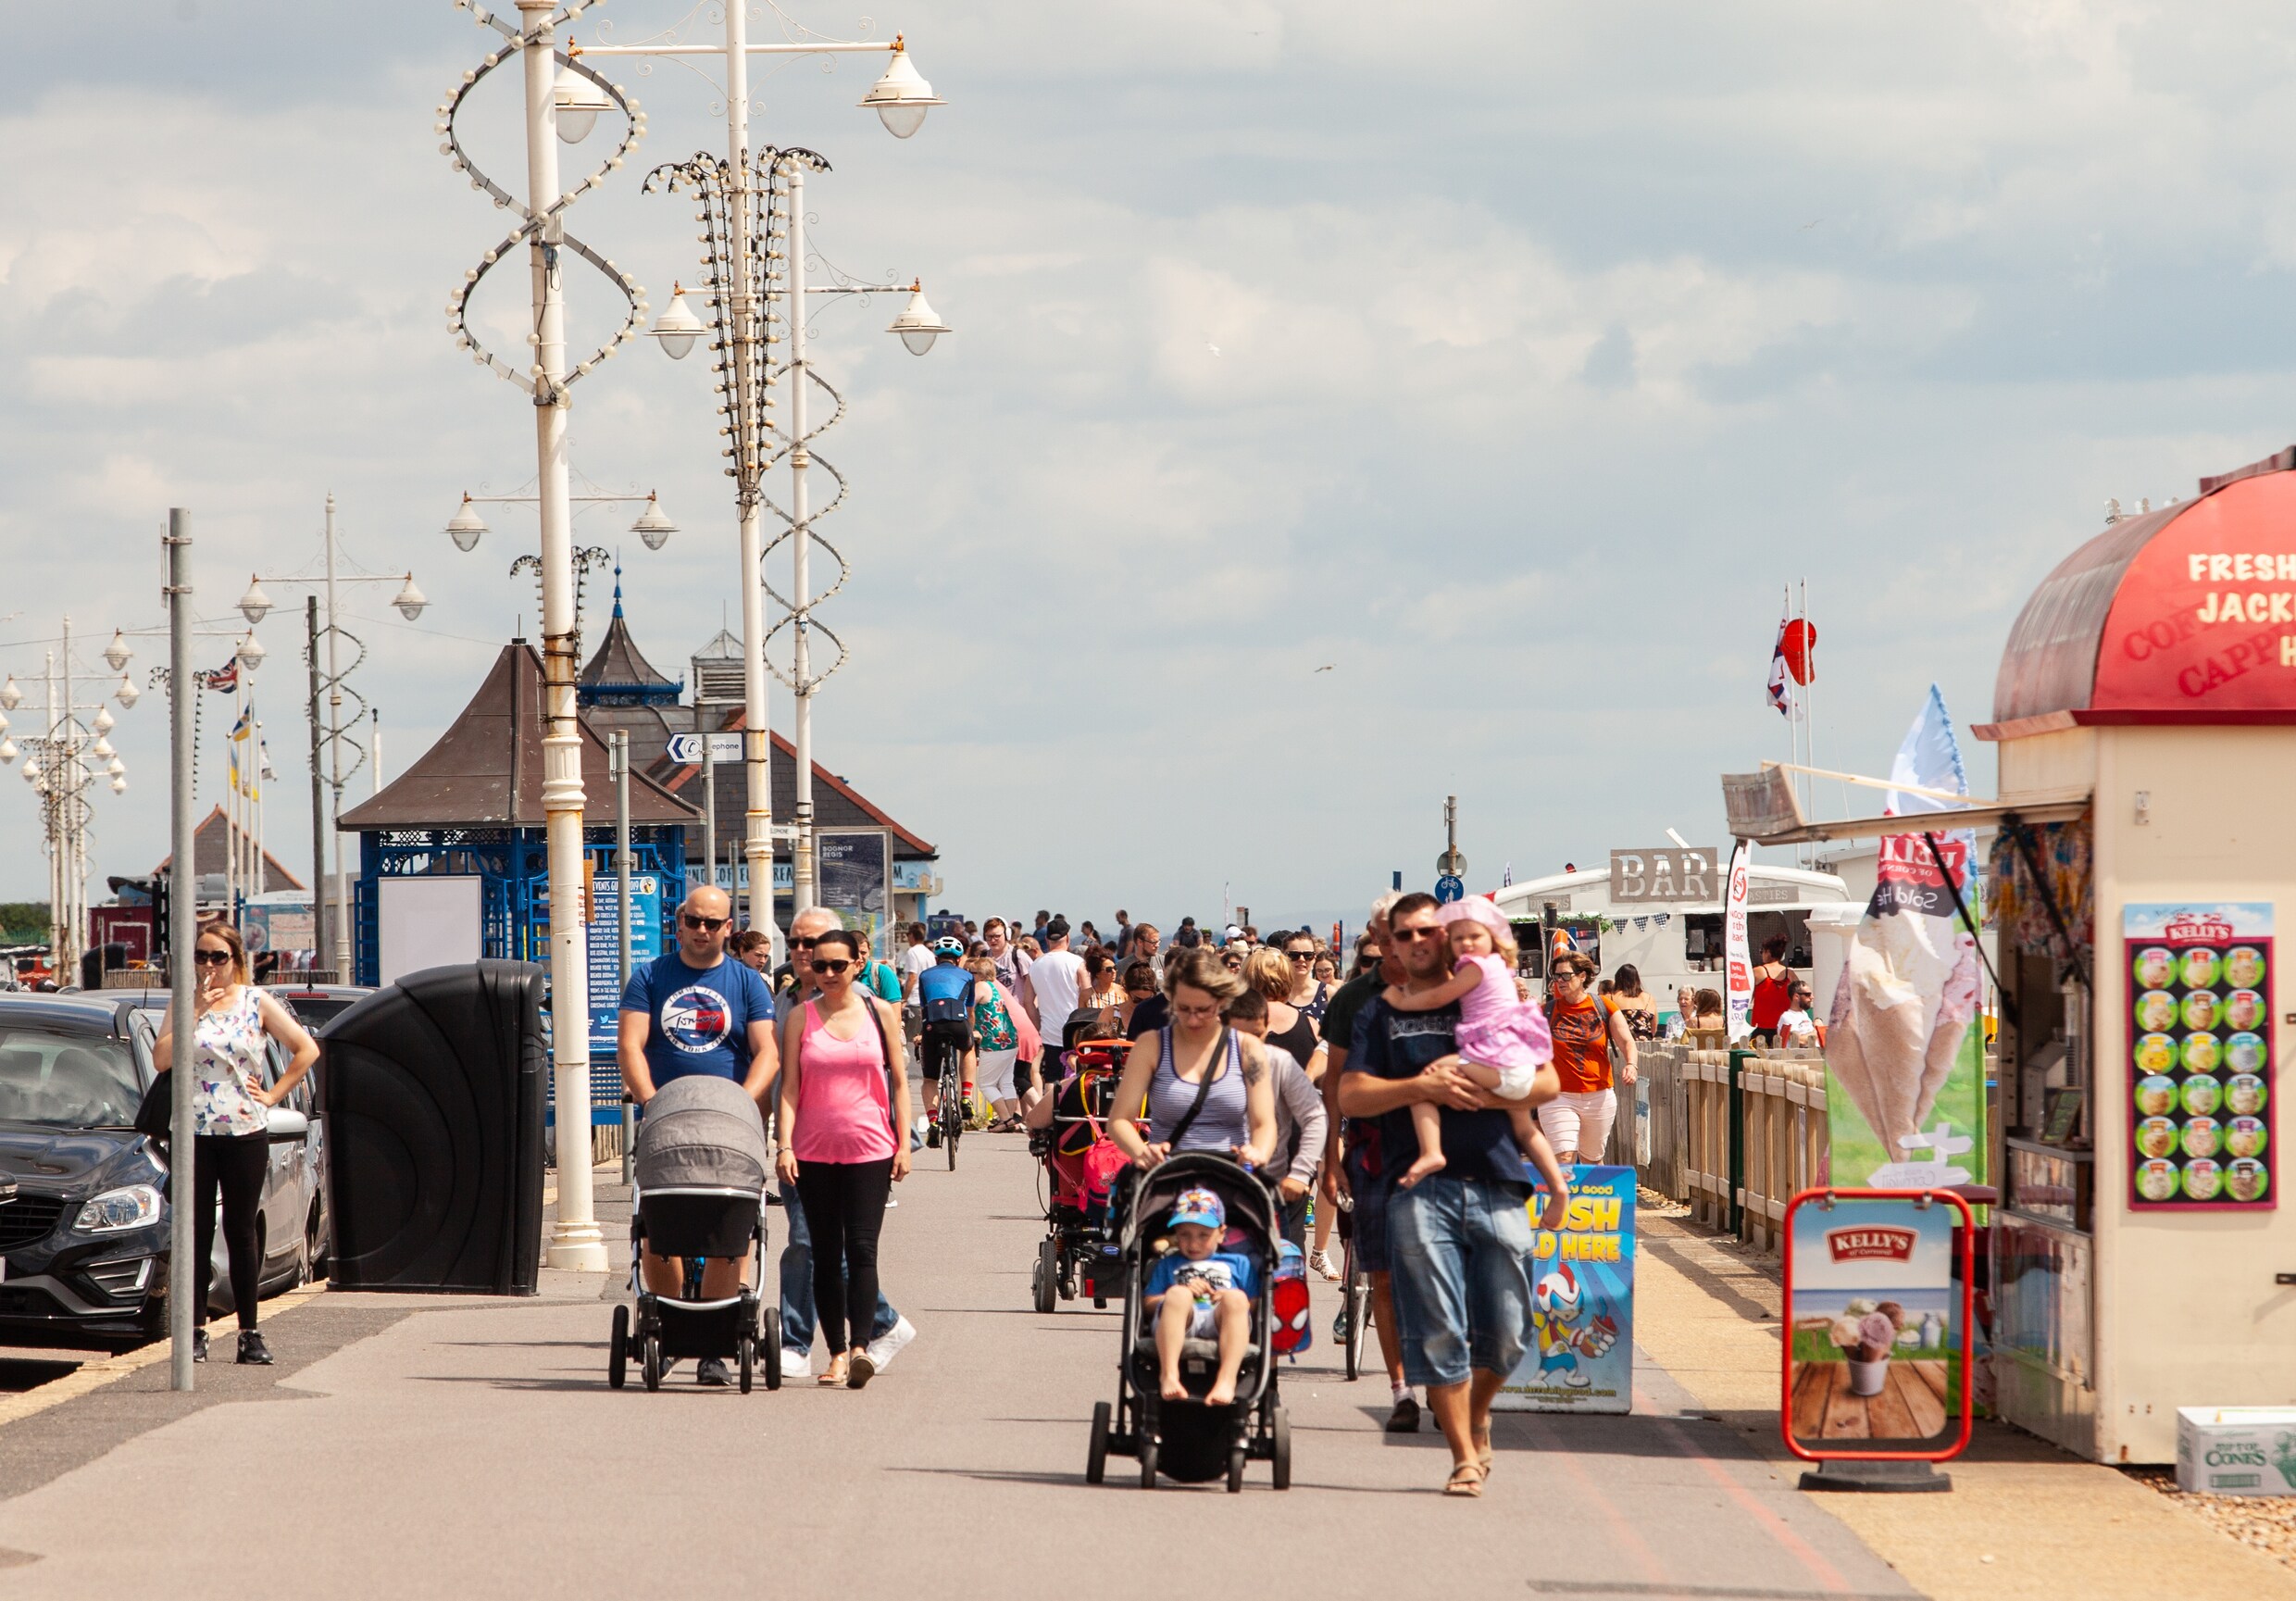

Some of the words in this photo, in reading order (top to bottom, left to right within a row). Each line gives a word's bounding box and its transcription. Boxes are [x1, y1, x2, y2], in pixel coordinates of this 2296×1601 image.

[2196, 592, 2296, 623] JACK
[711, 743, 740, 751] ephone
[1618, 853, 1710, 898] BAR
[1749, 889, 1789, 902] ASTIES
[1581, 1185, 1613, 1194] GOOD
[1526, 1196, 1622, 1232] LUSH
[1560, 1233, 1622, 1262] HERE
[1835, 1233, 1909, 1251] KELLY'S
[2205, 1449, 2267, 1467] CONES
